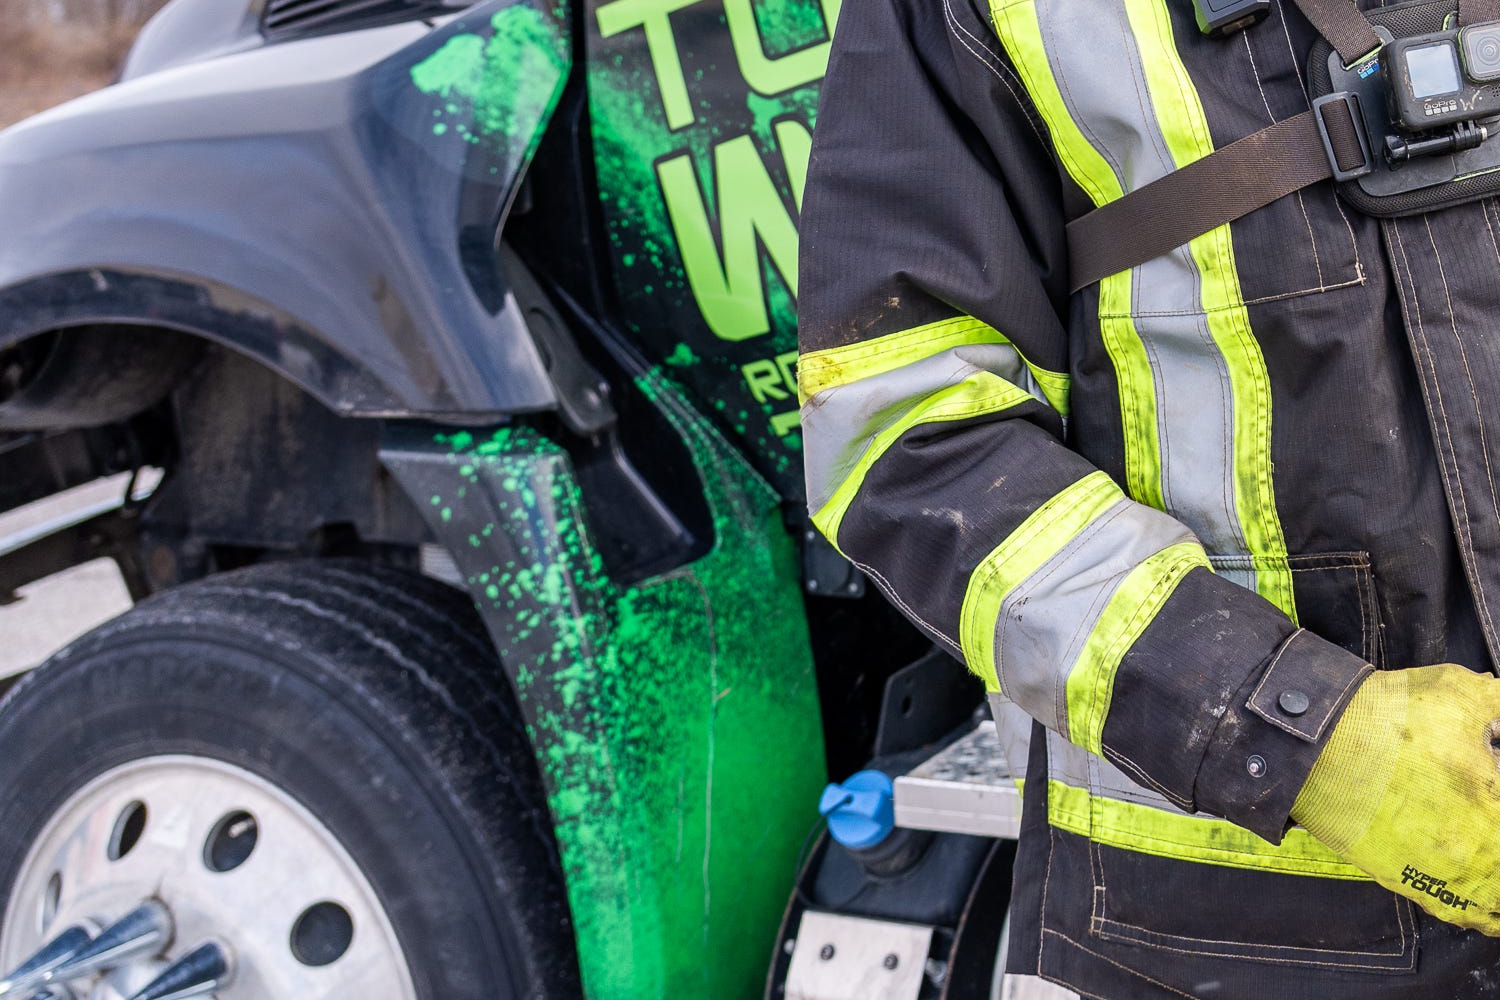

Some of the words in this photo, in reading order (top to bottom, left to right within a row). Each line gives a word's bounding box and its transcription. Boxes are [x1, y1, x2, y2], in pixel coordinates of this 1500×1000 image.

[1423, 99, 1457, 111] GoPro
[1403, 864, 1448, 888] HYPER
[1401, 871, 1469, 911] TOUGH
